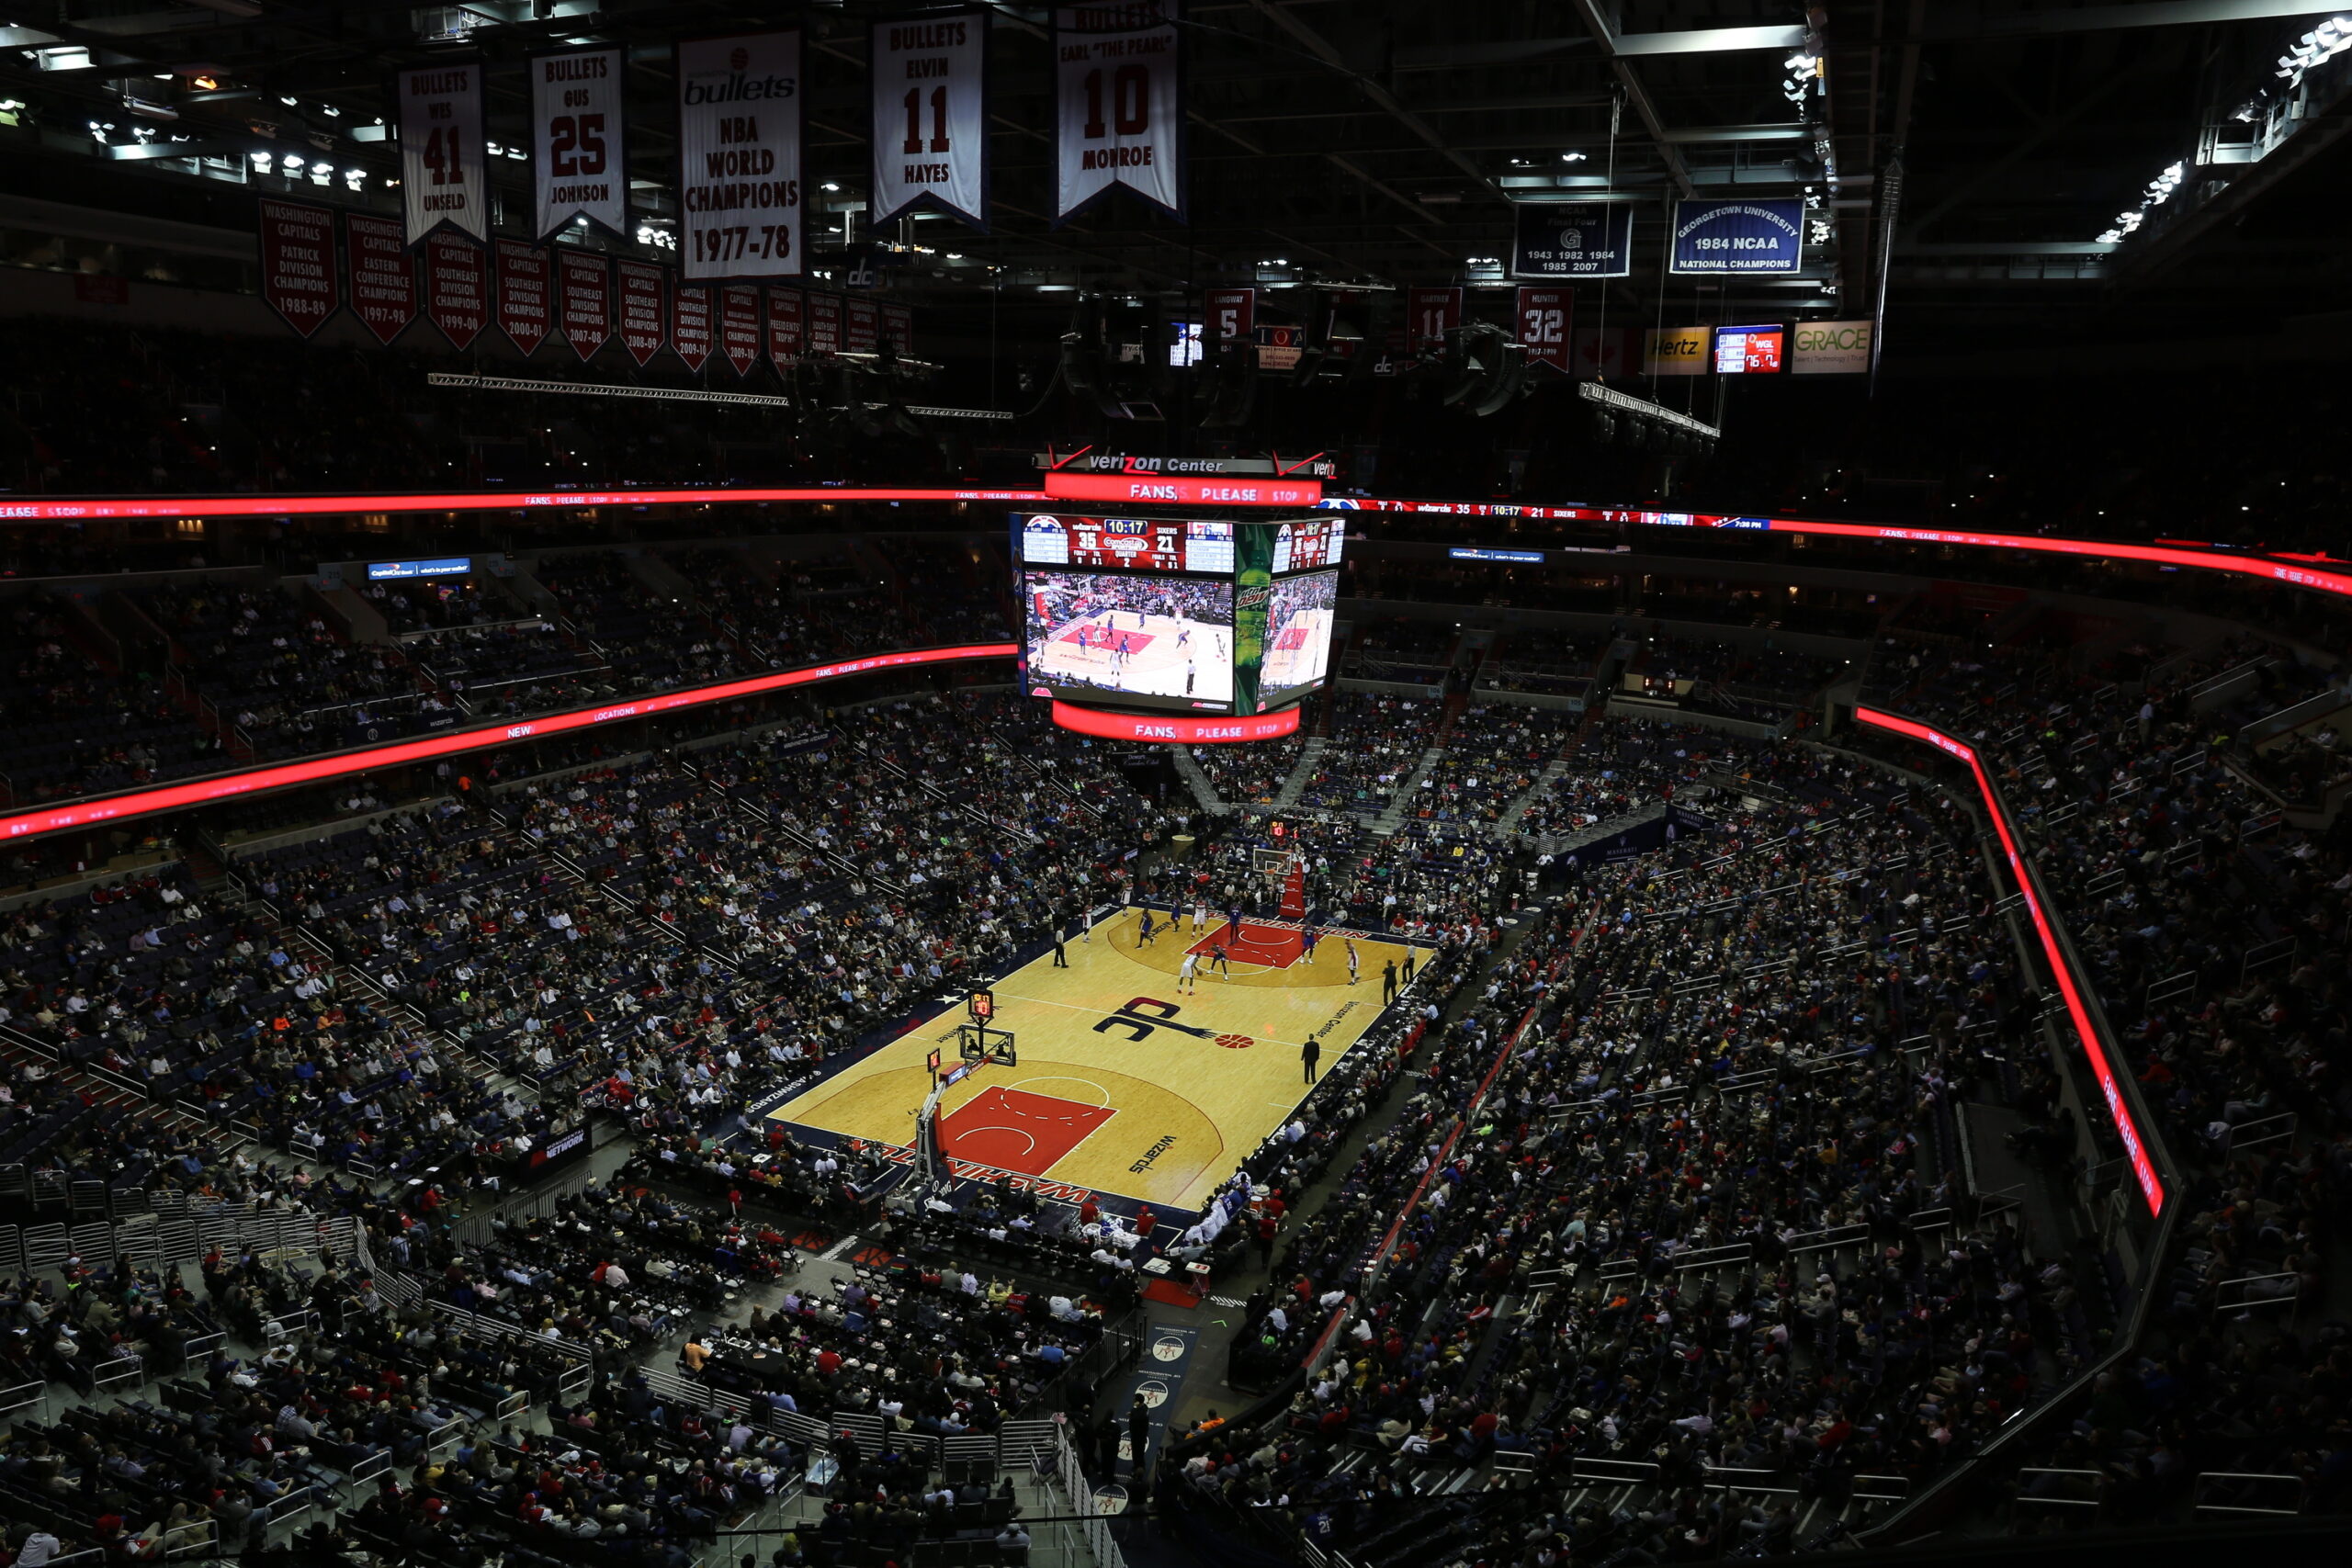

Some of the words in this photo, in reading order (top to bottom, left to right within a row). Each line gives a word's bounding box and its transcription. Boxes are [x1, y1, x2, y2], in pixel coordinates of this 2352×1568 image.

[1075, 2, 1159, 29] BULLETS
[890, 22, 965, 51] BULLETS
[1061, 44, 1090, 62] EARL
[546, 57, 607, 83] BULLETS
[907, 58, 948, 78] ELVIN
[412, 71, 468, 96] BULLETS
[684, 73, 796, 106] bullets
[564, 89, 589, 107] GUS
[1084, 64, 1148, 139] 10
[428, 102, 452, 120] WES
[904, 86, 949, 154] 11
[720, 117, 757, 144] NBA
[550, 114, 606, 177] 25
[423, 125, 463, 186] 41
[1082, 146, 1151, 170] MONROE
[707, 150, 774, 178] WORLD
[905, 164, 949, 184] HAYES
[424, 193, 465, 211] UNSELD
[551, 184, 608, 204] JOHNSON
[685, 181, 797, 212] CHAMPIONS
[265, 204, 331, 226] WASHINGTON
[1679, 206, 1742, 238] GEORGETOWN
[1744, 206, 1798, 237] UNIVERSITY
[277, 223, 321, 241] CAPITALS
[351, 219, 401, 238] WASHINGTO
[363, 237, 401, 253] CAPITALS
[695, 225, 790, 263] 1977-78
[1695, 238, 1729, 250] 1984
[1734, 237, 1779, 249] NCAA
[281, 245, 320, 262] PATRICK
[440, 248, 473, 265] CAPITALS
[1528, 251, 1552, 259] 1943
[1589, 251, 1614, 259] 1984
[279, 261, 322, 276] DIVISION
[365, 257, 399, 272] EASTERN
[509, 260, 540, 274] CAPITALS
[562, 254, 605, 271] WASHINGTON
[1679, 260, 1727, 268] NATIONAL
[356, 272, 410, 288] CONFERENCE
[435, 267, 478, 283] SOUTHEAST
[570, 269, 598, 283] CAPITALS
[621, 265, 661, 279] WASHINGTON
[274, 276, 329, 293] CHAMPIONS
[441, 282, 475, 296] DIVISION
[505, 277, 543, 292] SOUTHEAST
[628, 278, 654, 291] CAPITALS
[359, 287, 407, 302] CHAMPIONS
[509, 291, 540, 304] DIVISION
[567, 286, 603, 300] SOUTHEAST
[729, 294, 752, 306] CAPITALS
[1215, 296, 1244, 304] LANGWAY
[1420, 295, 1449, 303] GARTNER
[1532, 295, 1558, 303] HUNTER
[280, 297, 325, 315] 1988-89
[435, 296, 481, 310] CHAMPIONS
[570, 299, 599, 312] DIVISION
[626, 295, 657, 308] SOUTHEAST
[678, 302, 707, 314] SOUTHEAST
[364, 306, 405, 323] 1997-98
[504, 303, 544, 318] CHAMPIONS
[567, 311, 604, 326] CHAMPIONS
[628, 307, 655, 320] DIVISION
[440, 315, 478, 331] 1999-00
[509, 321, 542, 337] 2000-01
[625, 319, 658, 332] CHAMPIONS
[681, 315, 706, 327] DIVISION
[1220, 310, 1237, 338] 5
[1422, 310, 1444, 341] 11
[1524, 309, 1564, 343] 32
[570, 329, 601, 344] 2007-08
[628, 335, 657, 349] 2008-09
[677, 328, 708, 340] CHAMPIONS
[728, 332, 755, 343] CHAMPIONS
[1795, 329, 1868, 351] GRACE
[680, 343, 706, 355] 2009-10
[730, 347, 753, 359] 2009-10
[1652, 339, 1699, 355] Hertz
[1090, 453, 1161, 474] verizon
[1167, 459, 1223, 472] Center
[1131, 485, 1179, 502] FANS,
[1202, 489, 1257, 502] PLEASE
[1272, 491, 1296, 502] STOP
[1457, 504, 1469, 513] 35
[1494, 507, 1519, 515] 10:17
[1532, 508, 1544, 517] 21
[1554, 510, 1576, 518] SIXERS
[1110, 521, 1143, 534] 10:17
[1079, 533, 1096, 547] 35
[1158, 536, 1174, 551] 21
[839, 663, 857, 673] PLEASE
[508, 726, 531, 739] NEW
[594, 707, 635, 721] LOCATIONS
[1136, 725, 1176, 739] FANS,
[1197, 728, 1242, 738] PLEASE
[1257, 726, 1278, 734] STOP
[1316, 1020, 1340, 1038] Center
[547, 1131, 585, 1159] NETWORK
[1128, 1135, 1177, 1175] wizards
